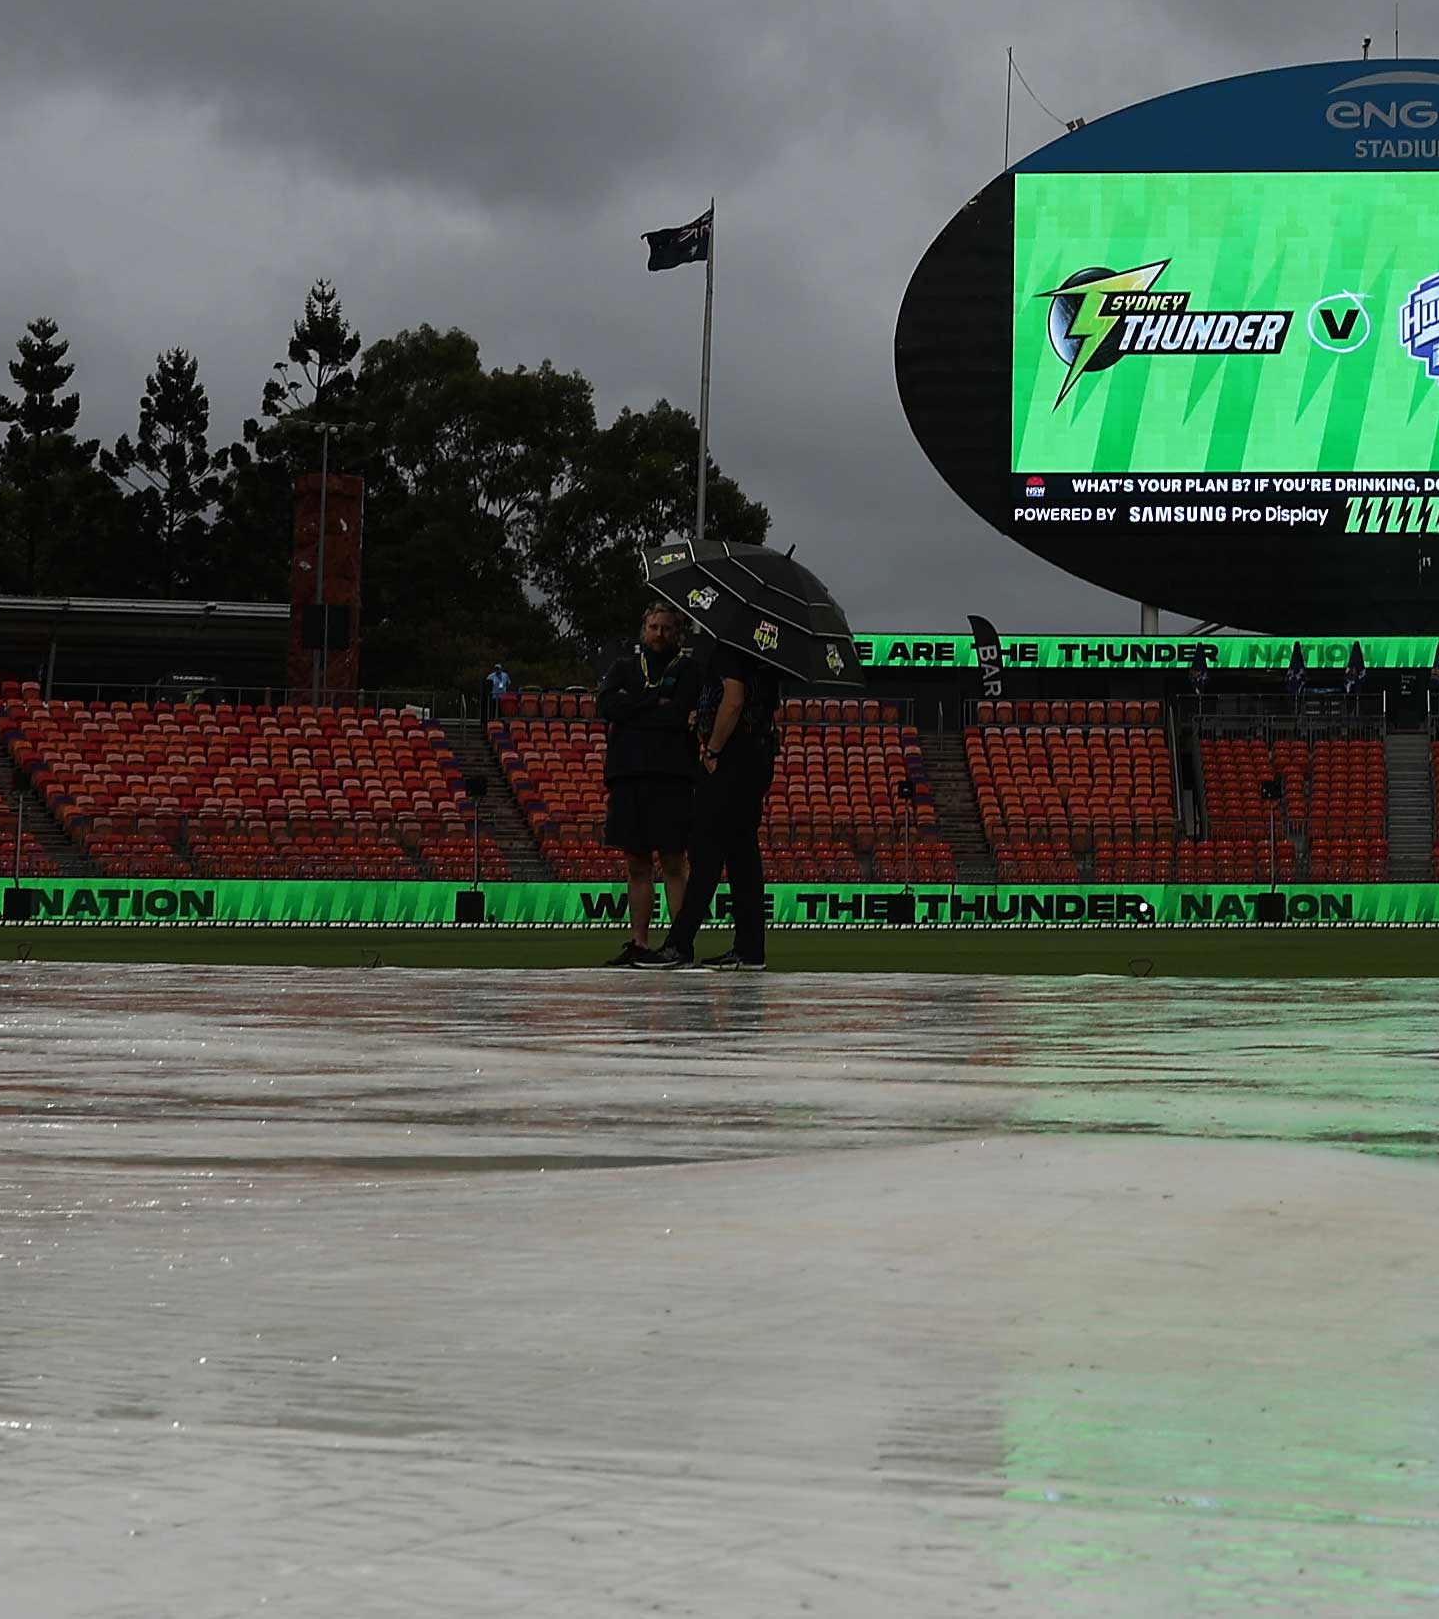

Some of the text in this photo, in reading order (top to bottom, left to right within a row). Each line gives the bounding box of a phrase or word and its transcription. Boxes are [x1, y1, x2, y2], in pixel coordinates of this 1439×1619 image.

[1110, 294, 1185, 311] SYDNEY
[1119, 315, 1285, 350] THUNDER
[1026, 487, 1045, 497] NSW
[1073, 479, 1134, 493] WHAT'S
[1138, 479, 1182, 493] YOUR
[1186, 479, 1227, 493] PLAN
[1232, 479, 1250, 493] B?
[1255, 479, 1269, 492] IF
[1273, 478, 1331, 492] YOU'RE
[1335, 478, 1420, 493] DRINKING,
[1014, 506, 1329, 526] POWERED BY SAMSUNG Pro Display
[854, 642, 873, 660] E
[888, 642, 954, 661] ARE
[971, 643, 1039, 661] HE
[1058, 644, 1218, 662] THUNDER
[979, 645, 1002, 697] BAR
[32, 889, 216, 918] NATION
[797, 894, 892, 920] THE
[1180, 894, 1353, 920] NAON
